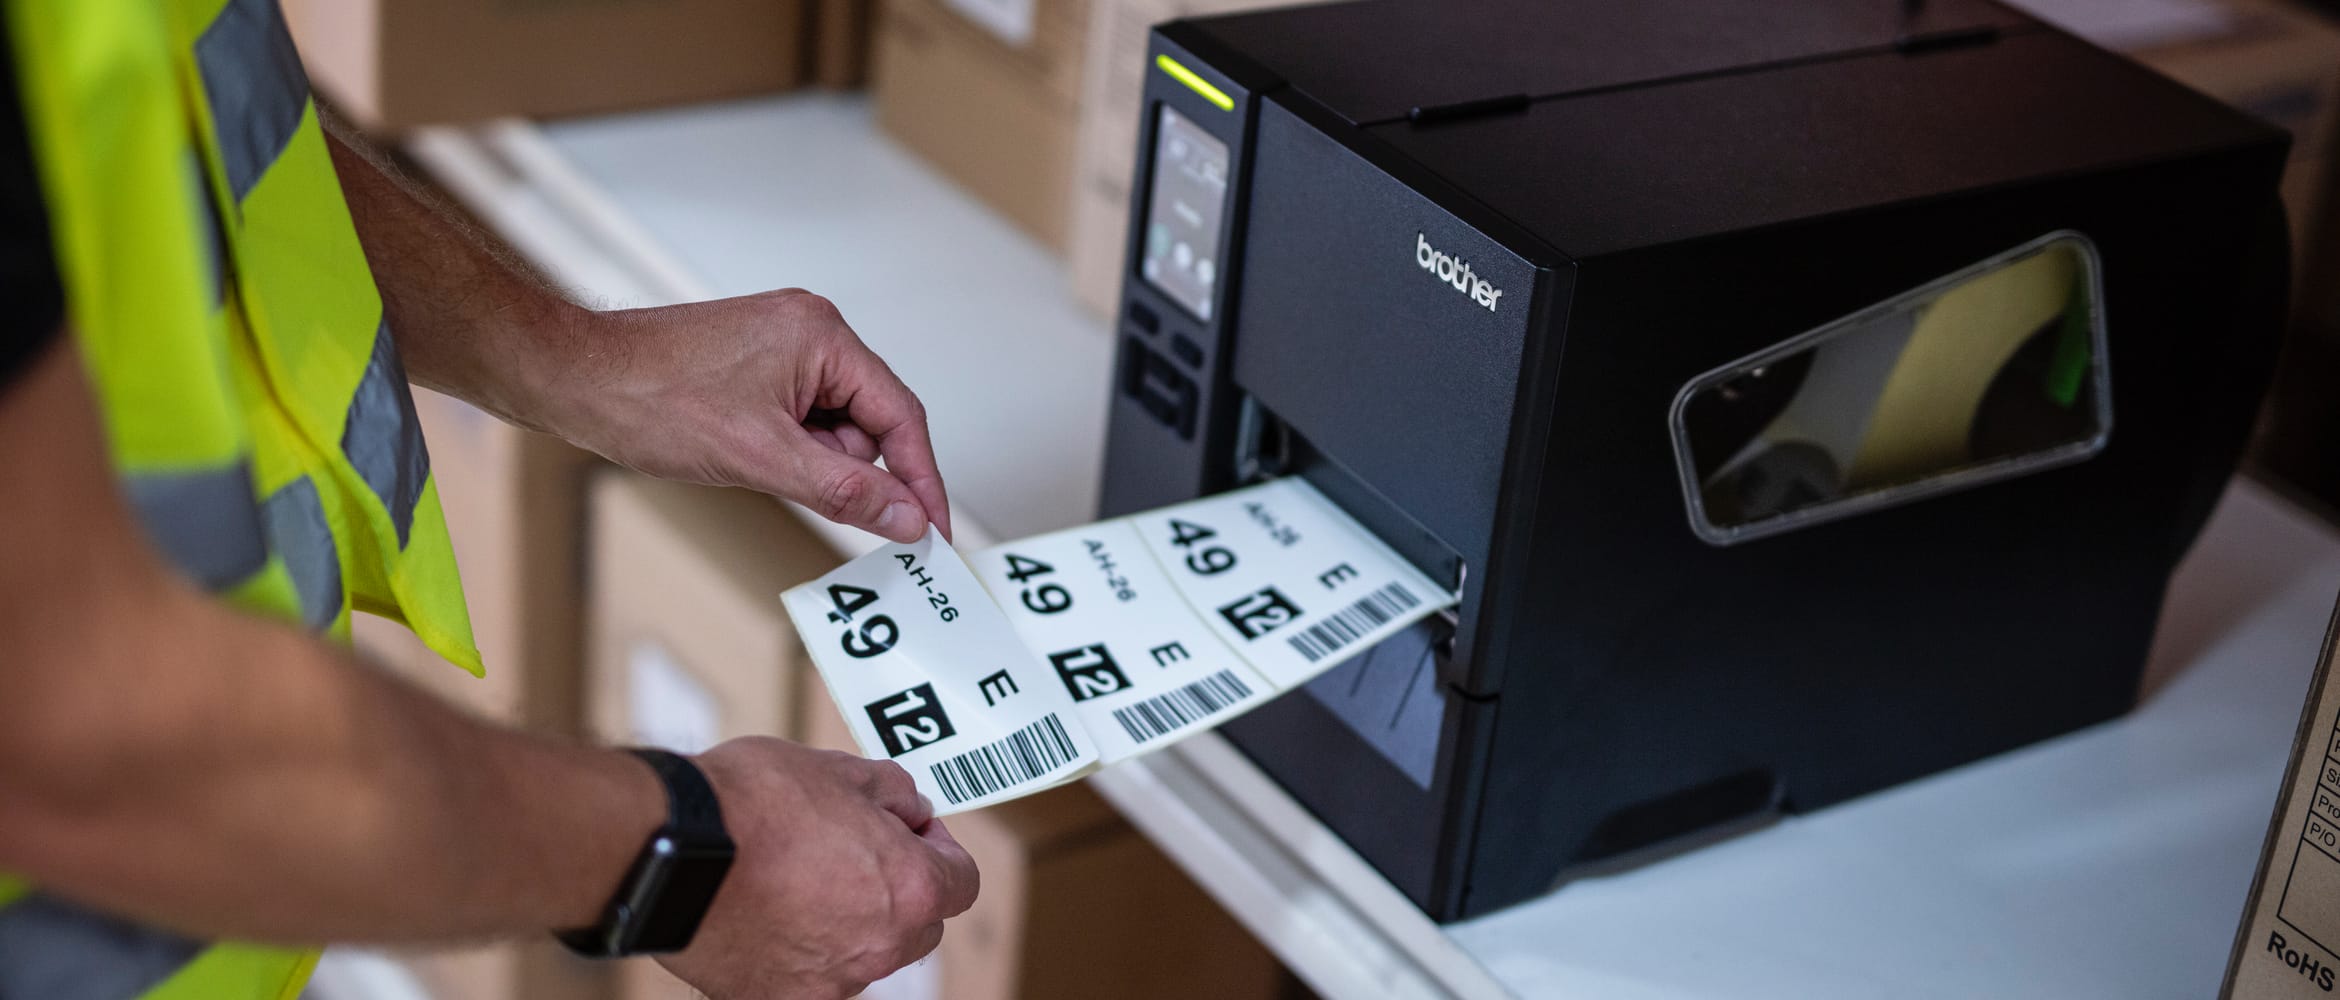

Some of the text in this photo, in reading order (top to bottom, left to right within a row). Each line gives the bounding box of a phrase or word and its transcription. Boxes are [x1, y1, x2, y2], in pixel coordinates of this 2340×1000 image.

[1416, 232, 1502, 312] brother
[1084, 539, 1137, 602] AH-26
[1168, 518, 1237, 577] 49
[1317, 562, 1358, 589] E
[894, 553, 959, 622] AH-26
[1005, 553, 1072, 615] 49
[1232, 589, 1290, 634] 12
[826, 583, 899, 658] 49
[1062, 646, 1119, 698] 12
[1149, 641, 1190, 667] E
[977, 668, 1019, 706] E
[883, 690, 941, 750] 12
[2327, 768, 2340, 787] Si
[2310, 822, 2336, 847] P/O
[2267, 930, 2335, 992] RoHS
